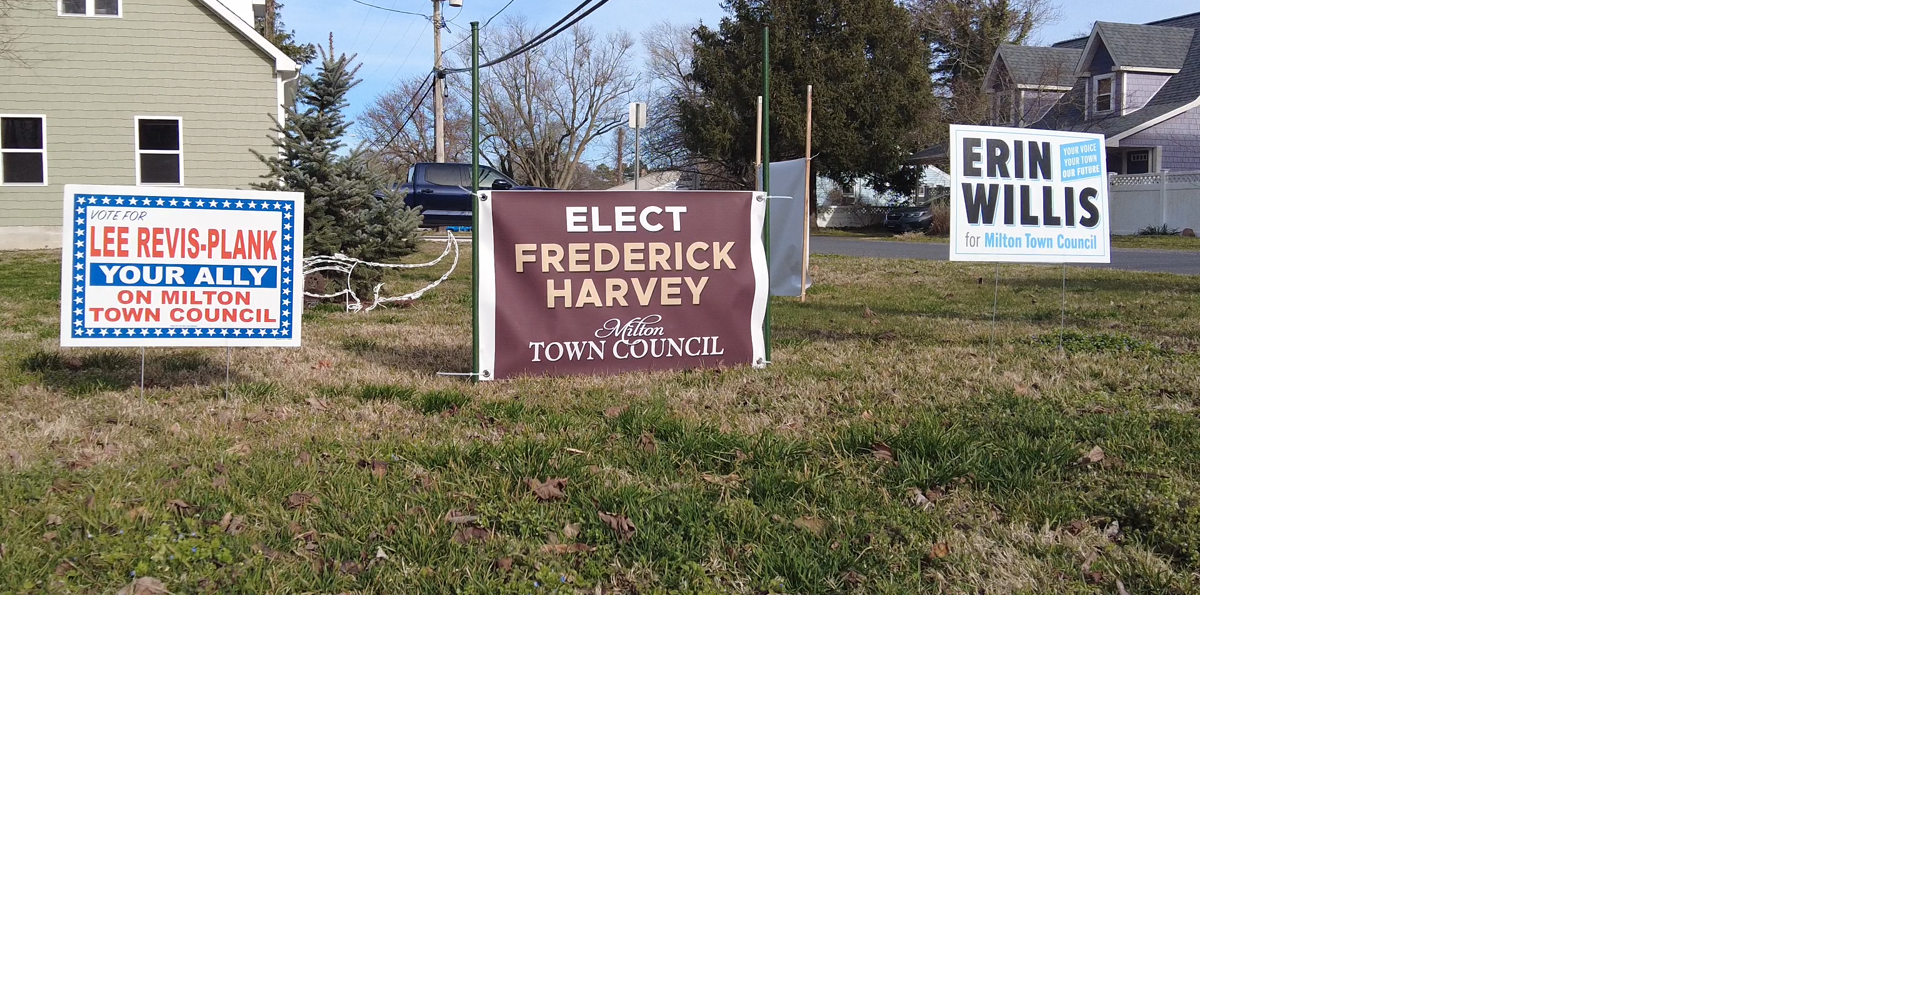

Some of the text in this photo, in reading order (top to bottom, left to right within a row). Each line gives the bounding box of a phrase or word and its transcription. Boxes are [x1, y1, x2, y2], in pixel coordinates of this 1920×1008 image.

[963, 138, 1053, 181] ERIN
[1063, 144, 1097, 155] YOUR VOICE
[1064, 154, 1097, 166] YOUR TOWN
[1063, 165, 1099, 178] OUR FUTURE
[90, 210, 147, 221] VOTE FOR
[962, 183, 1100, 228] WILLIS
[566, 206, 686, 232] ELECT
[90, 226, 277, 260] LEE REVIS-PLANK
[965, 232, 1096, 249] for Milton Town Council
[515, 242, 736, 272] FREDERICK
[99, 265, 268, 286] YOUR ALLY
[117, 290, 250, 305] ON MILTON
[547, 276, 709, 308] HARVEY
[89, 308, 276, 322] TOWN COUNCIL
[594, 314, 664, 346] Milton
[529, 336, 724, 362] TOWN COUNCIL
